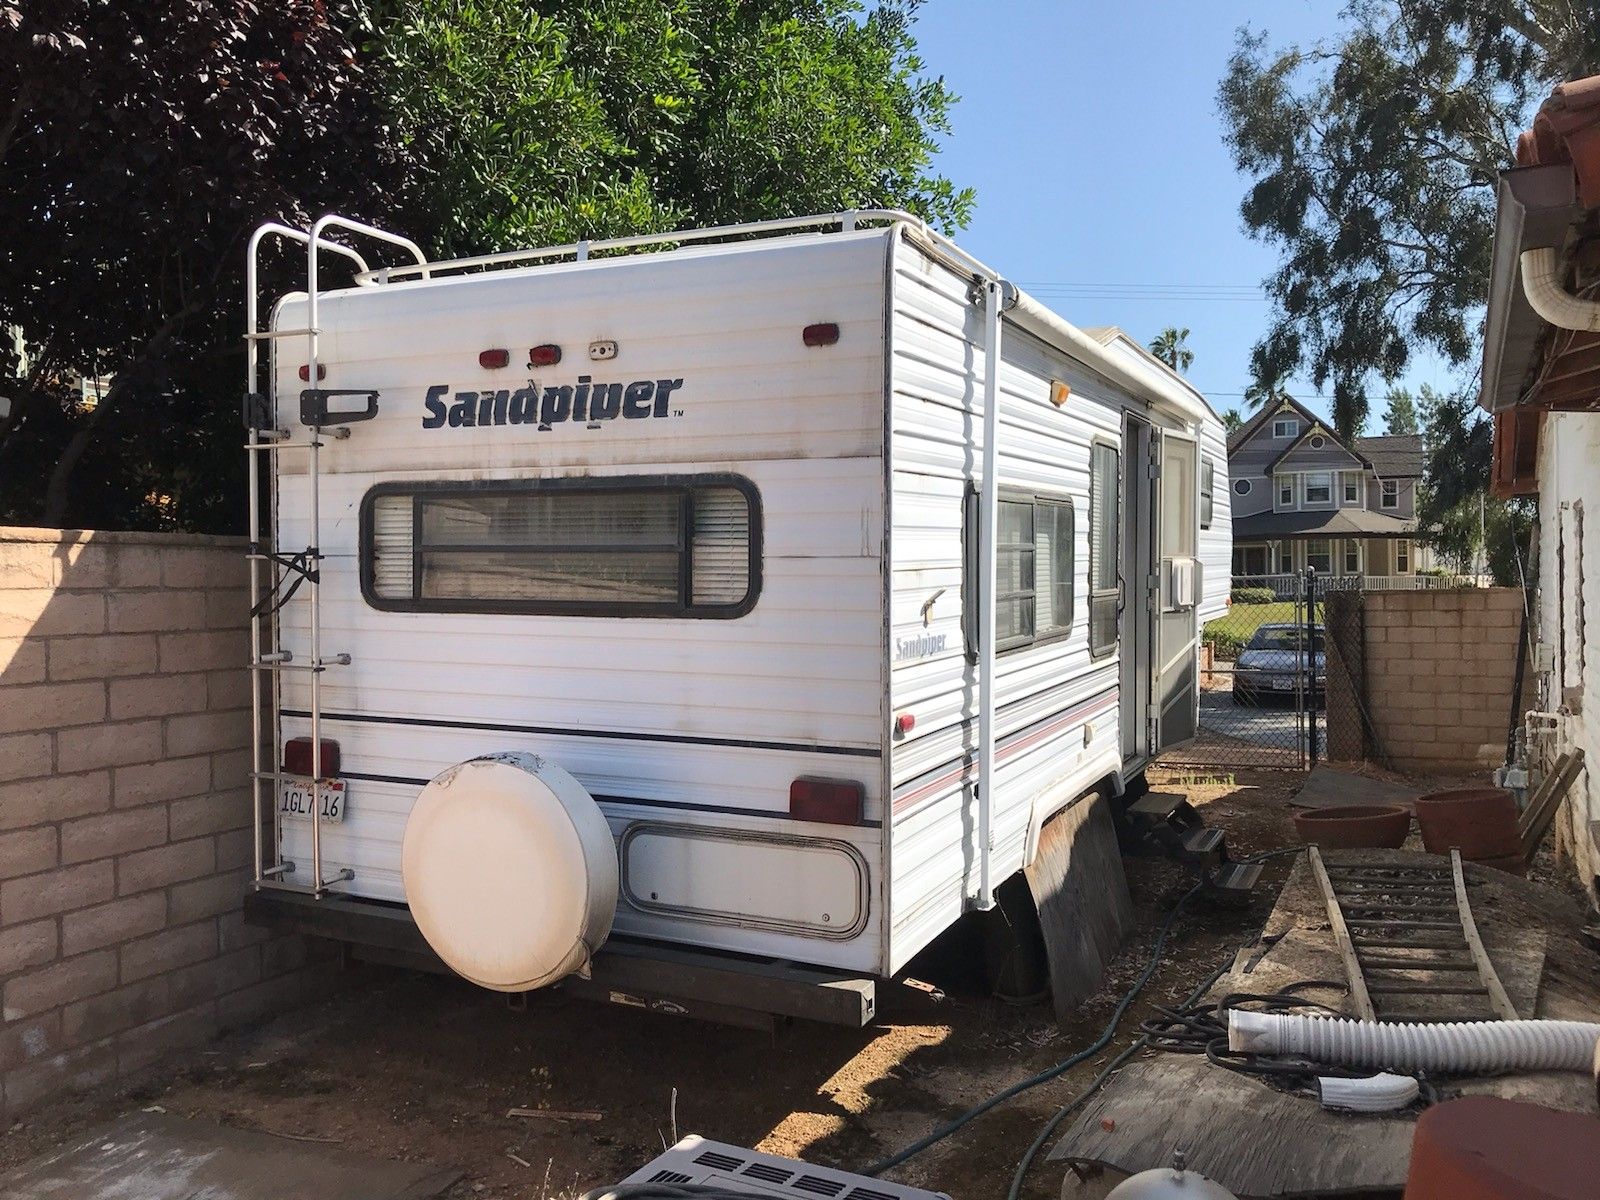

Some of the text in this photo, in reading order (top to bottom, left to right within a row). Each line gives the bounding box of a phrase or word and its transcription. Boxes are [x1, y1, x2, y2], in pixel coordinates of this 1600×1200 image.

[422, 375, 684, 431] Sandpiper
[896, 633, 946, 660] Sandpiper
[281, 790, 340, 817] 1GL716
